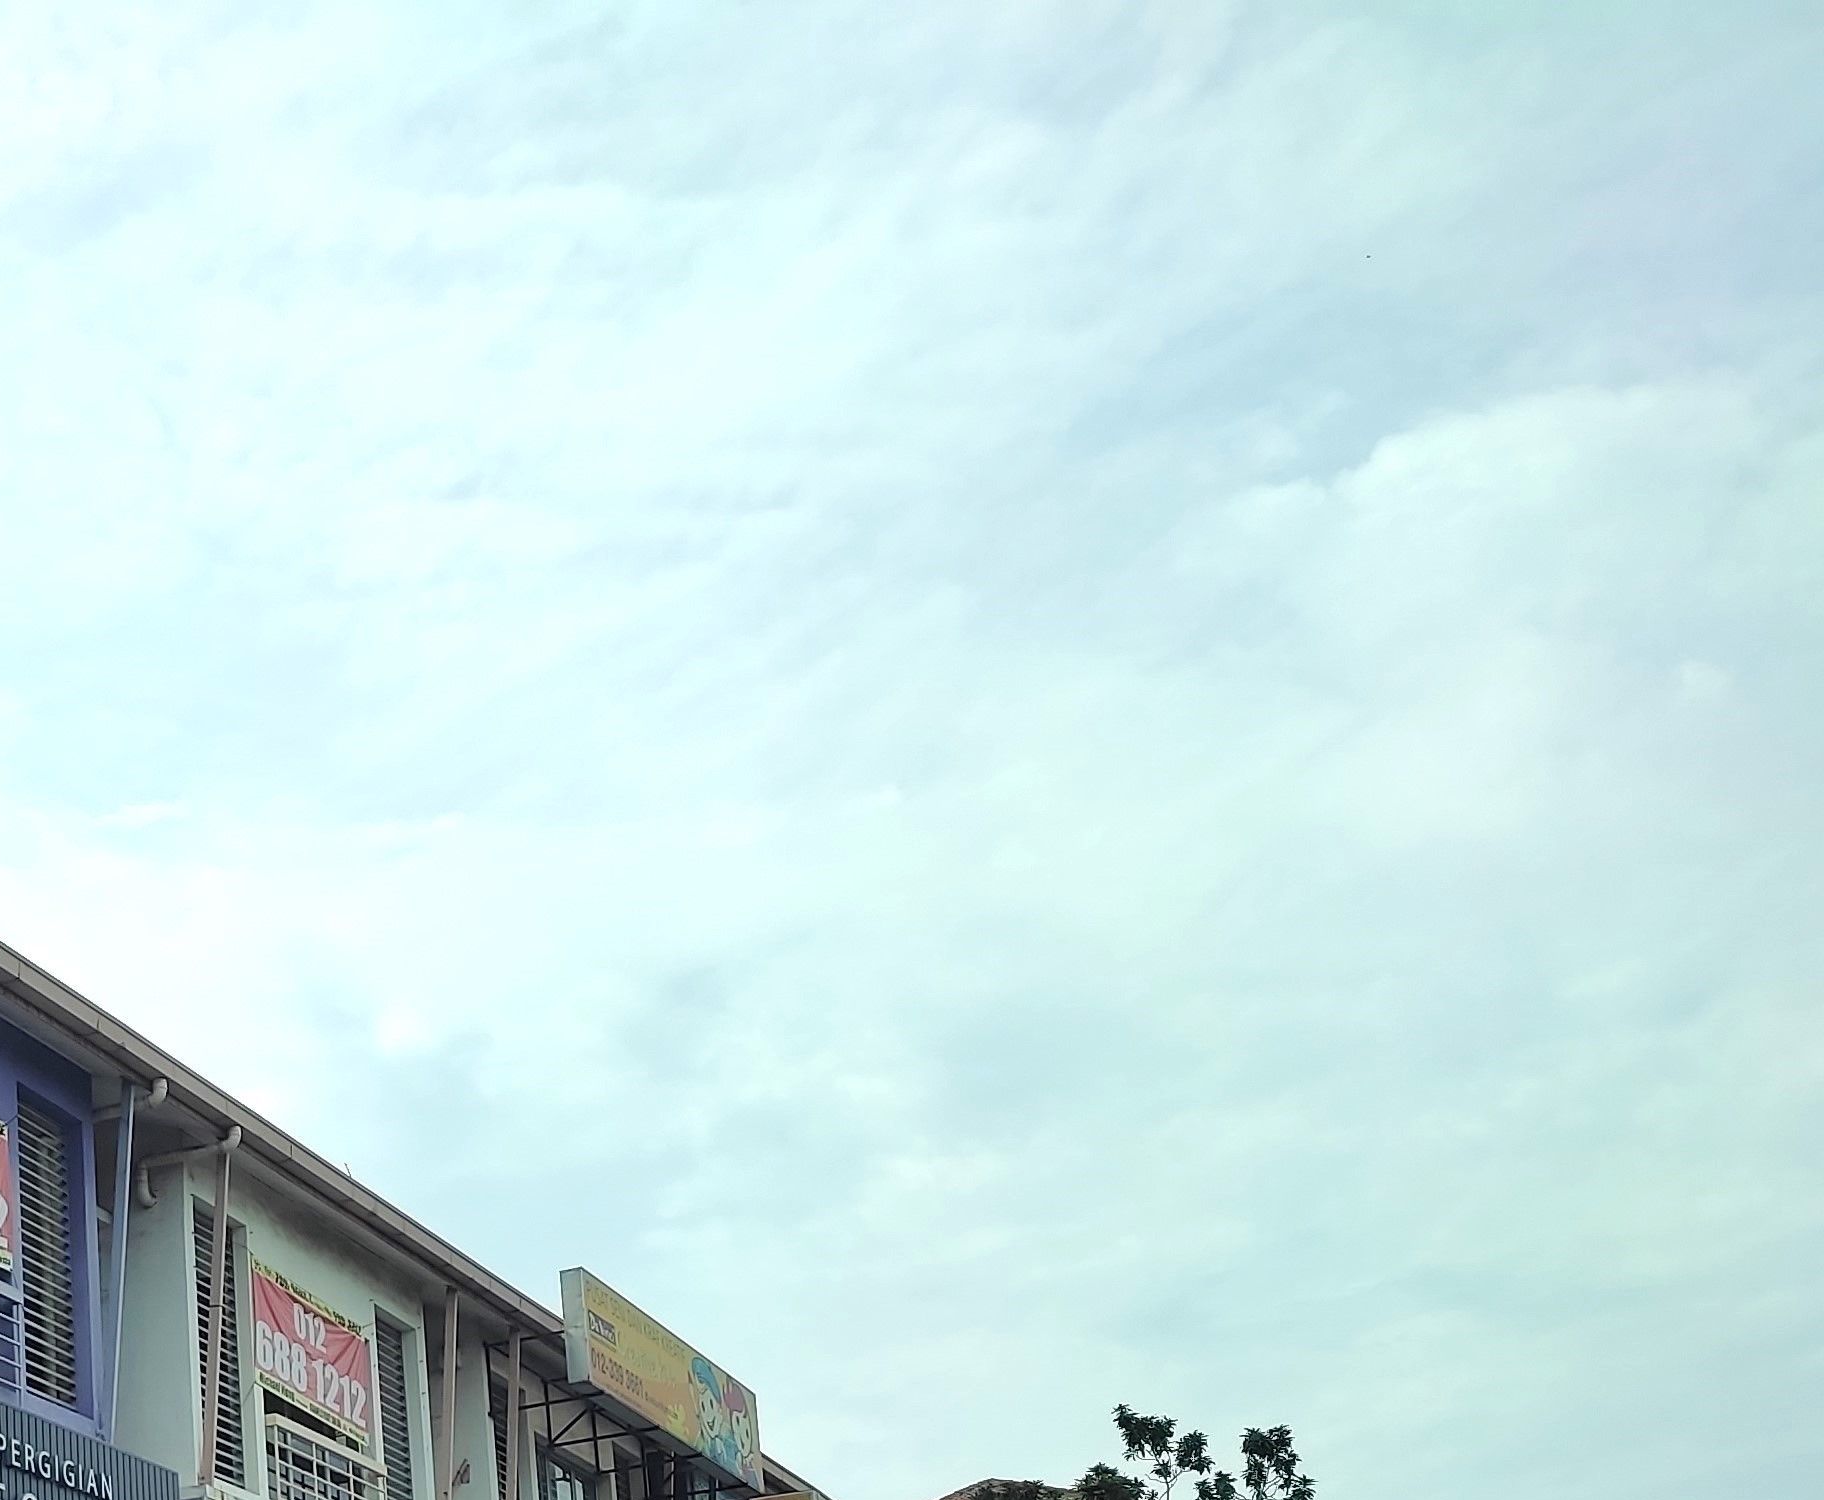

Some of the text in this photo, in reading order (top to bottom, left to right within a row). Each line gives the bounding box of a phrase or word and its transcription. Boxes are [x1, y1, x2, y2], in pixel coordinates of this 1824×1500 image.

[293, 1302, 326, 1352] 012
[256, 1320, 308, 1393] 688
[312, 1359, 366, 1427] 1212
